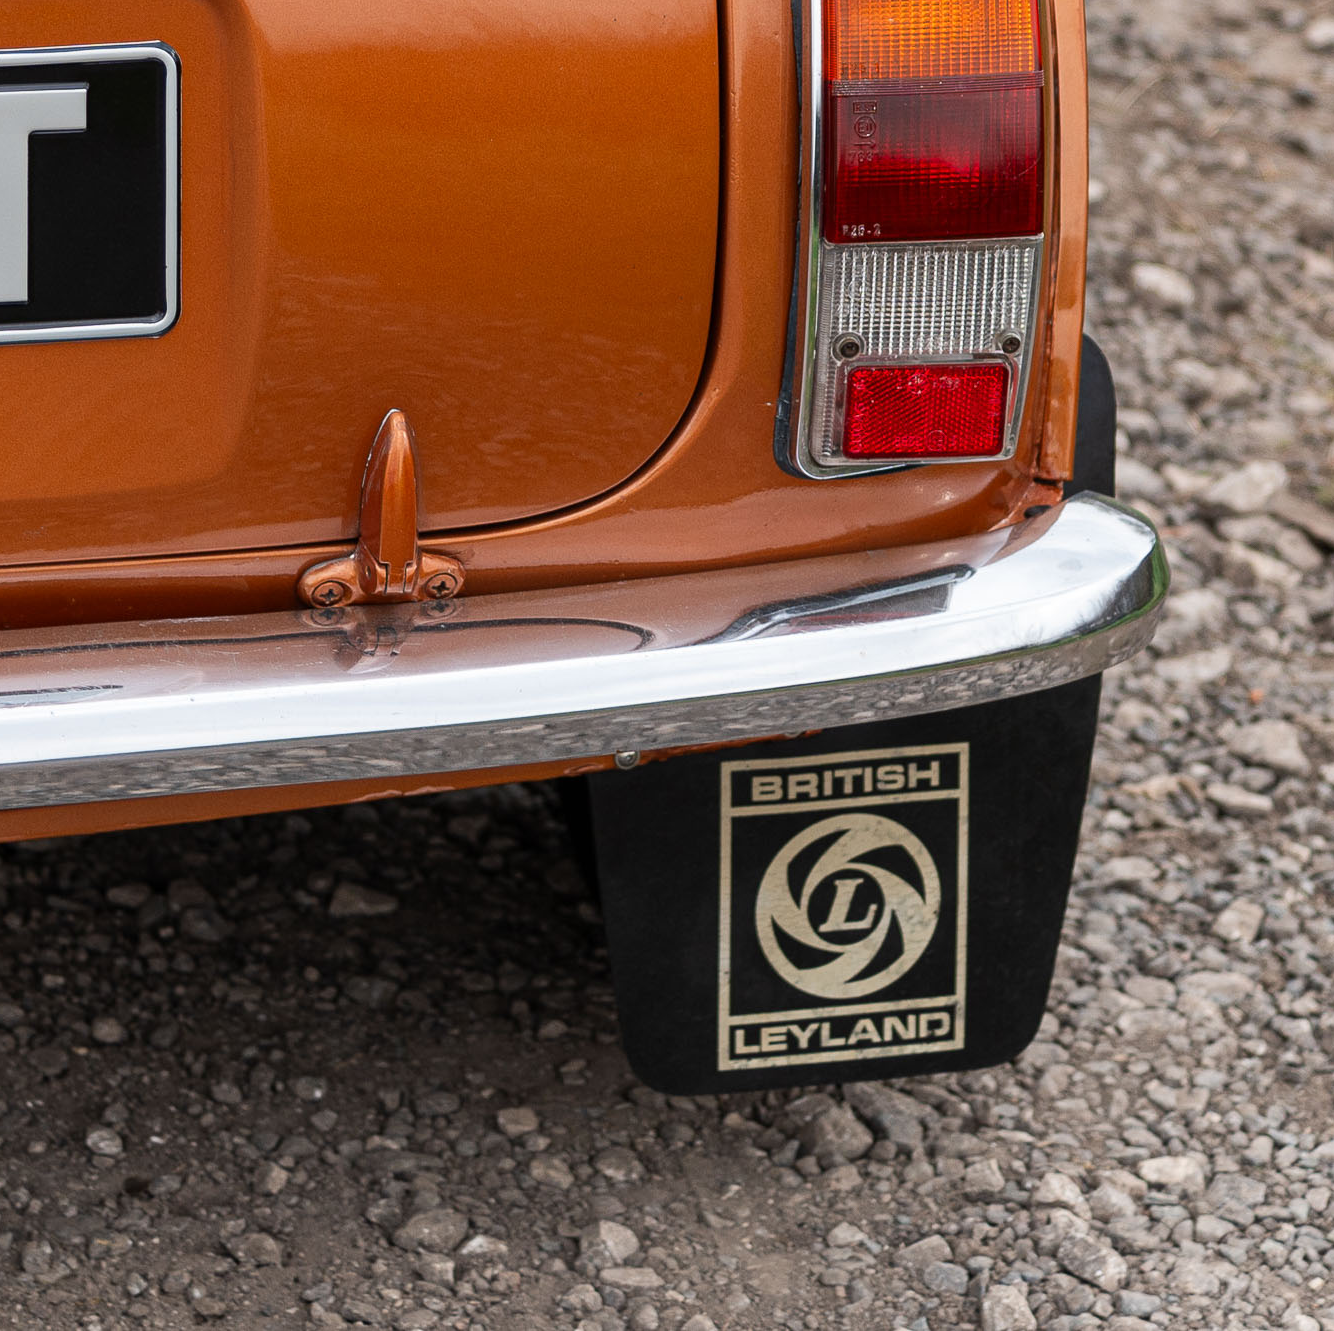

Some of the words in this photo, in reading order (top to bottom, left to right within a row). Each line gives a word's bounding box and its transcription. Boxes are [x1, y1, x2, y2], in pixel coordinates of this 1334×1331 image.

[752, 761, 940, 801] BRITISH
[819, 878, 878, 932] L
[735, 1012, 951, 1055] LEYLAND
